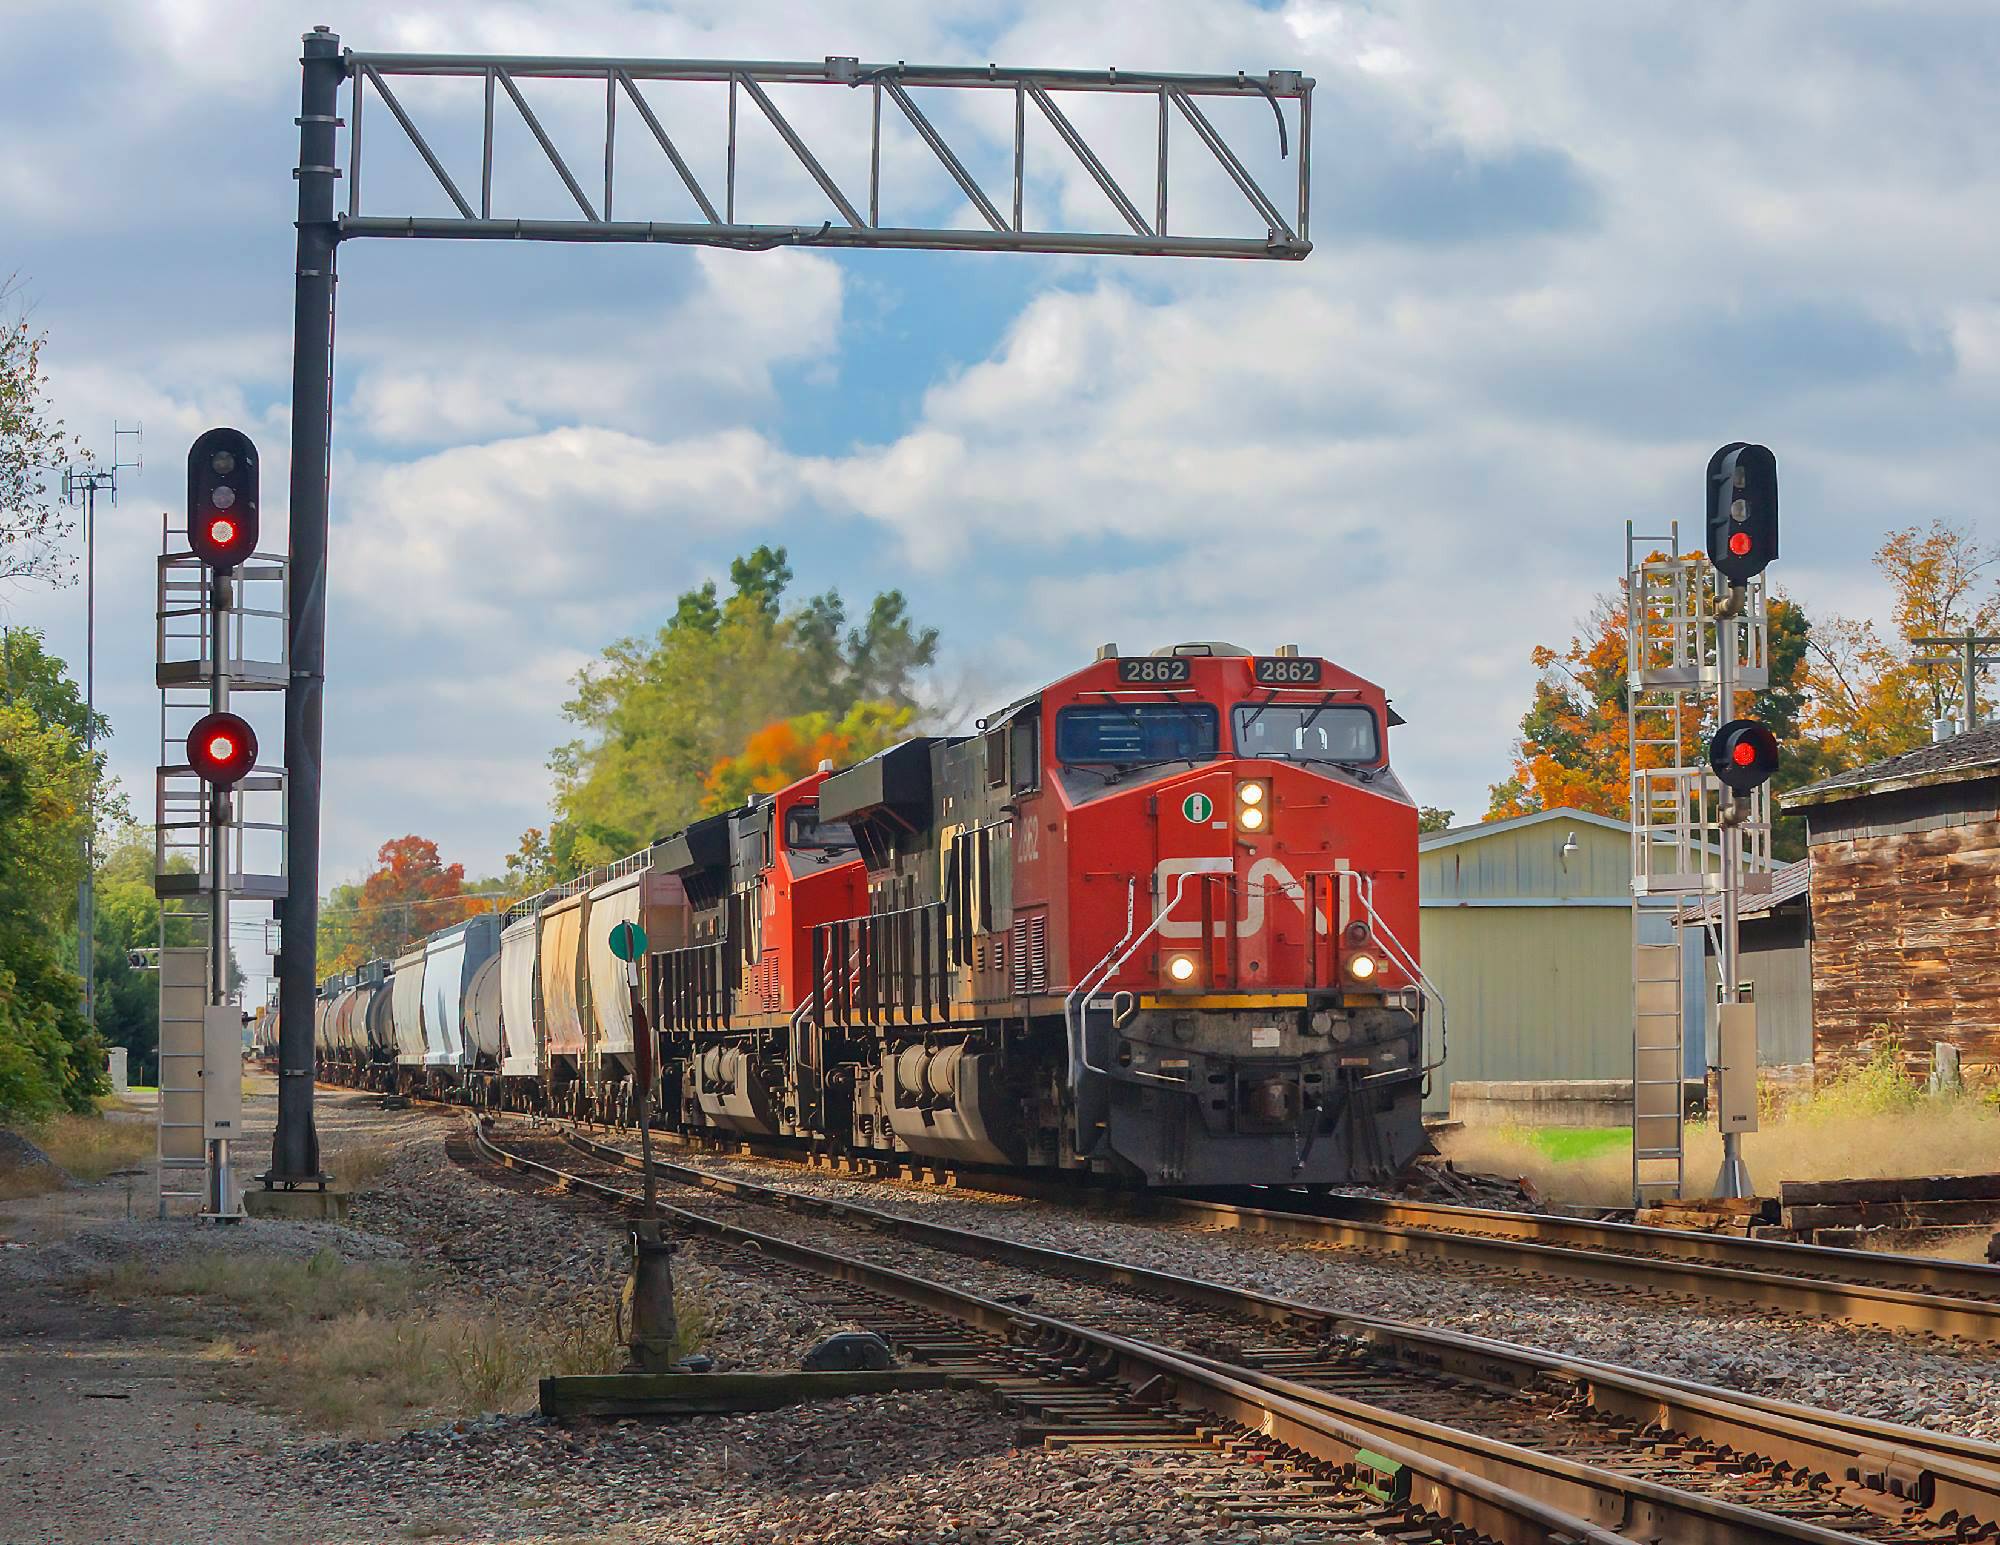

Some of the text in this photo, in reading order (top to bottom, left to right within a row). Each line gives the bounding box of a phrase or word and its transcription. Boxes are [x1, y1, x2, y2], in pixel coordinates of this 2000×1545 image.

[1127, 661, 1185, 681] 2862
[1261, 661, 1315, 681] 2862
[1152, 856, 1350, 938] CN
